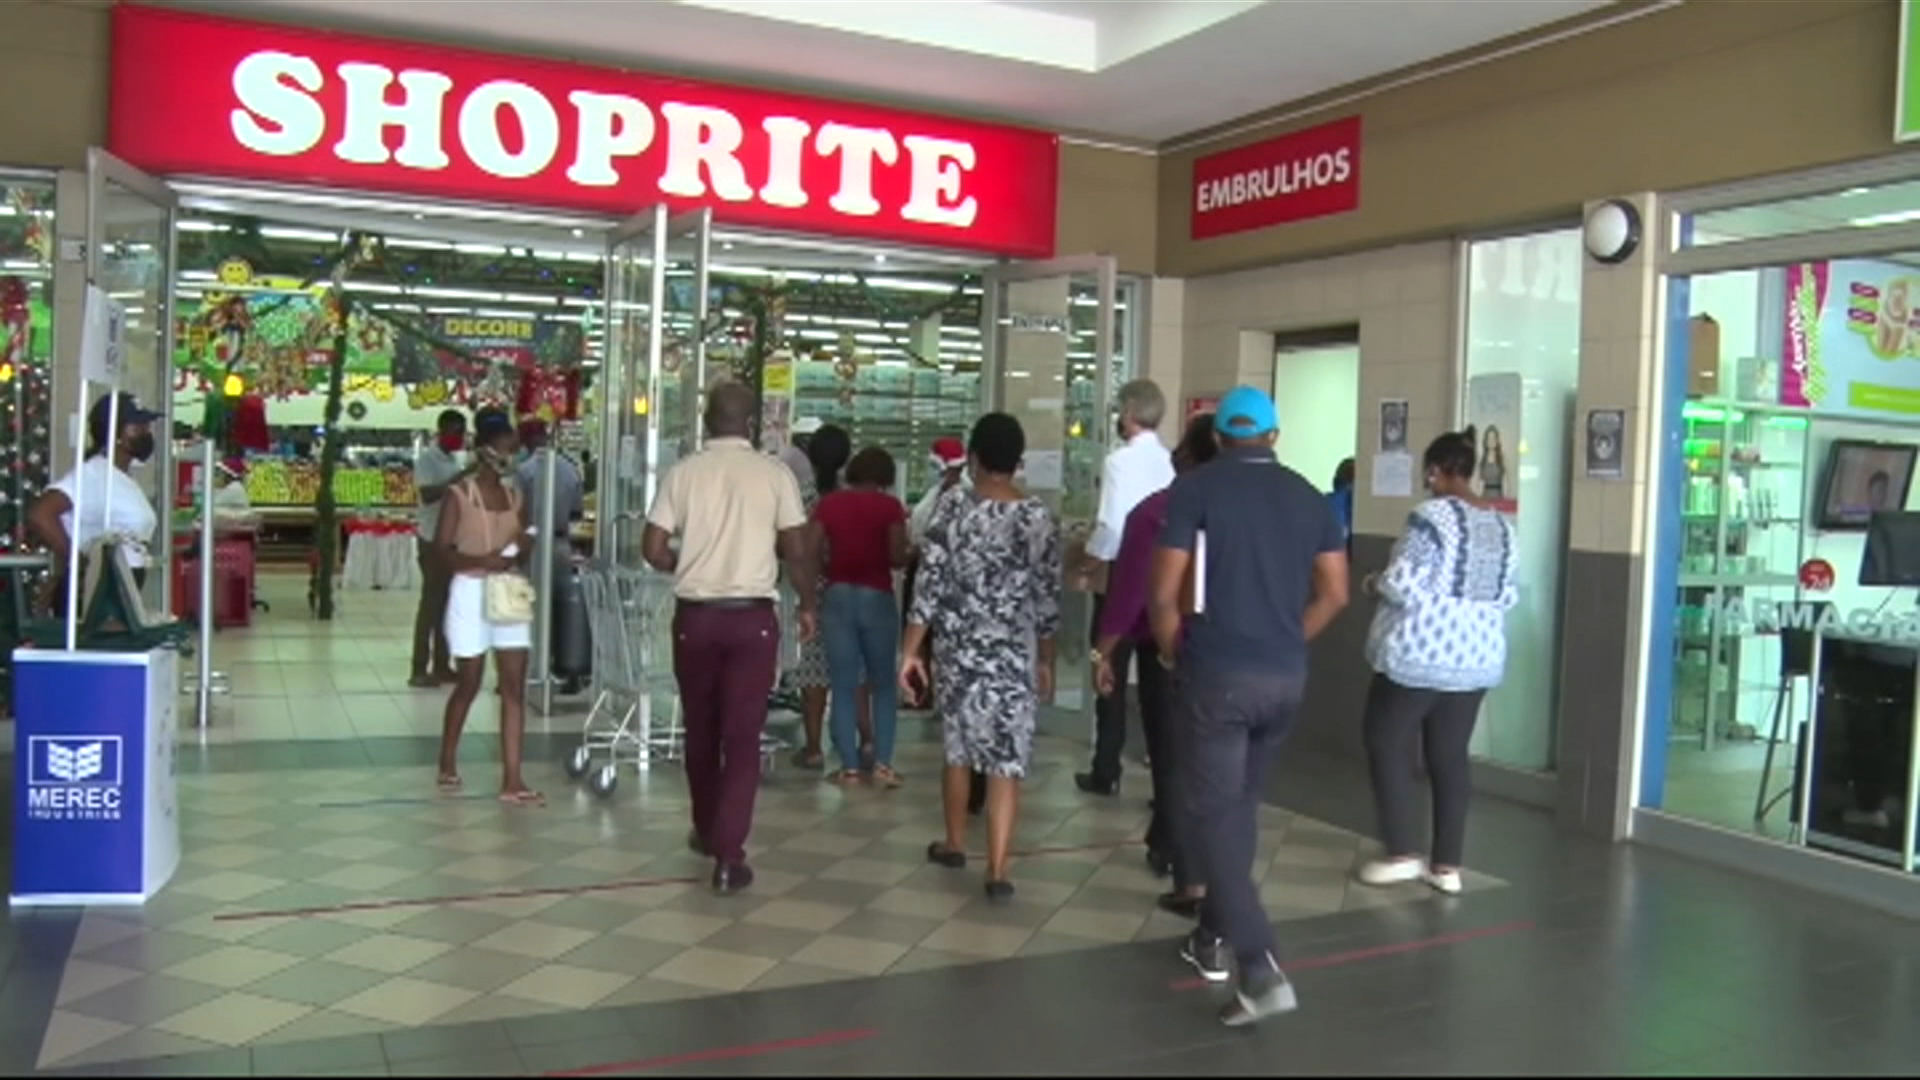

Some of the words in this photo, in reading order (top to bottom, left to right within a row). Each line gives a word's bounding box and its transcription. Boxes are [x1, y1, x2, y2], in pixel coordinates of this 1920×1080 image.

[230, 51, 978, 228] SHOPRITE
[1196, 147, 1350, 213] EMBRULHOS
[28, 788, 121, 808] MEREC
